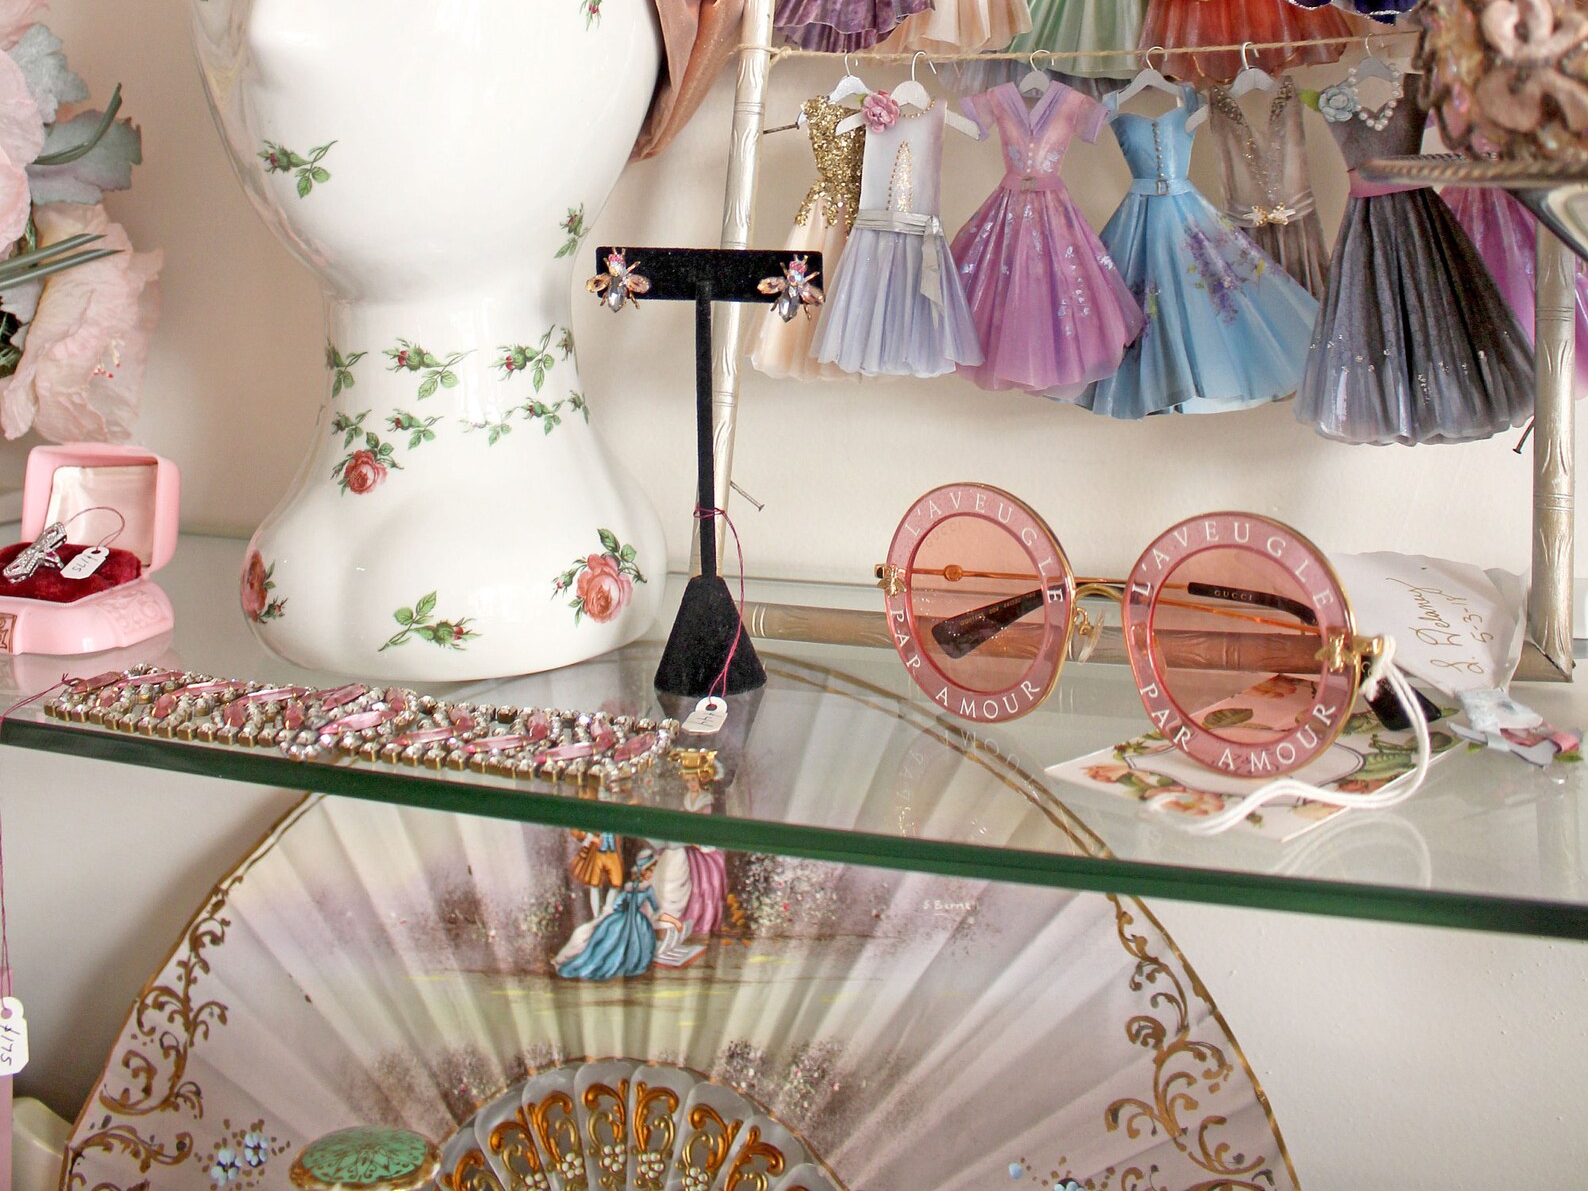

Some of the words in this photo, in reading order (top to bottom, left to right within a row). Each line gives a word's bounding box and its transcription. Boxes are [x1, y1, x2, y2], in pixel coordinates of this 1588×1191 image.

[905, 491, 1064, 604] L'AVEUGLE
[1131, 520, 1335, 609] L'AVEUGLE
[1214, 589, 1253, 601] GUCCI
[889, 609, 921, 675] PAR
[935, 679, 1041, 720] AMOUR
[1139, 683, 1191, 752] PAR
[1218, 703, 1336, 772] AMOUR
